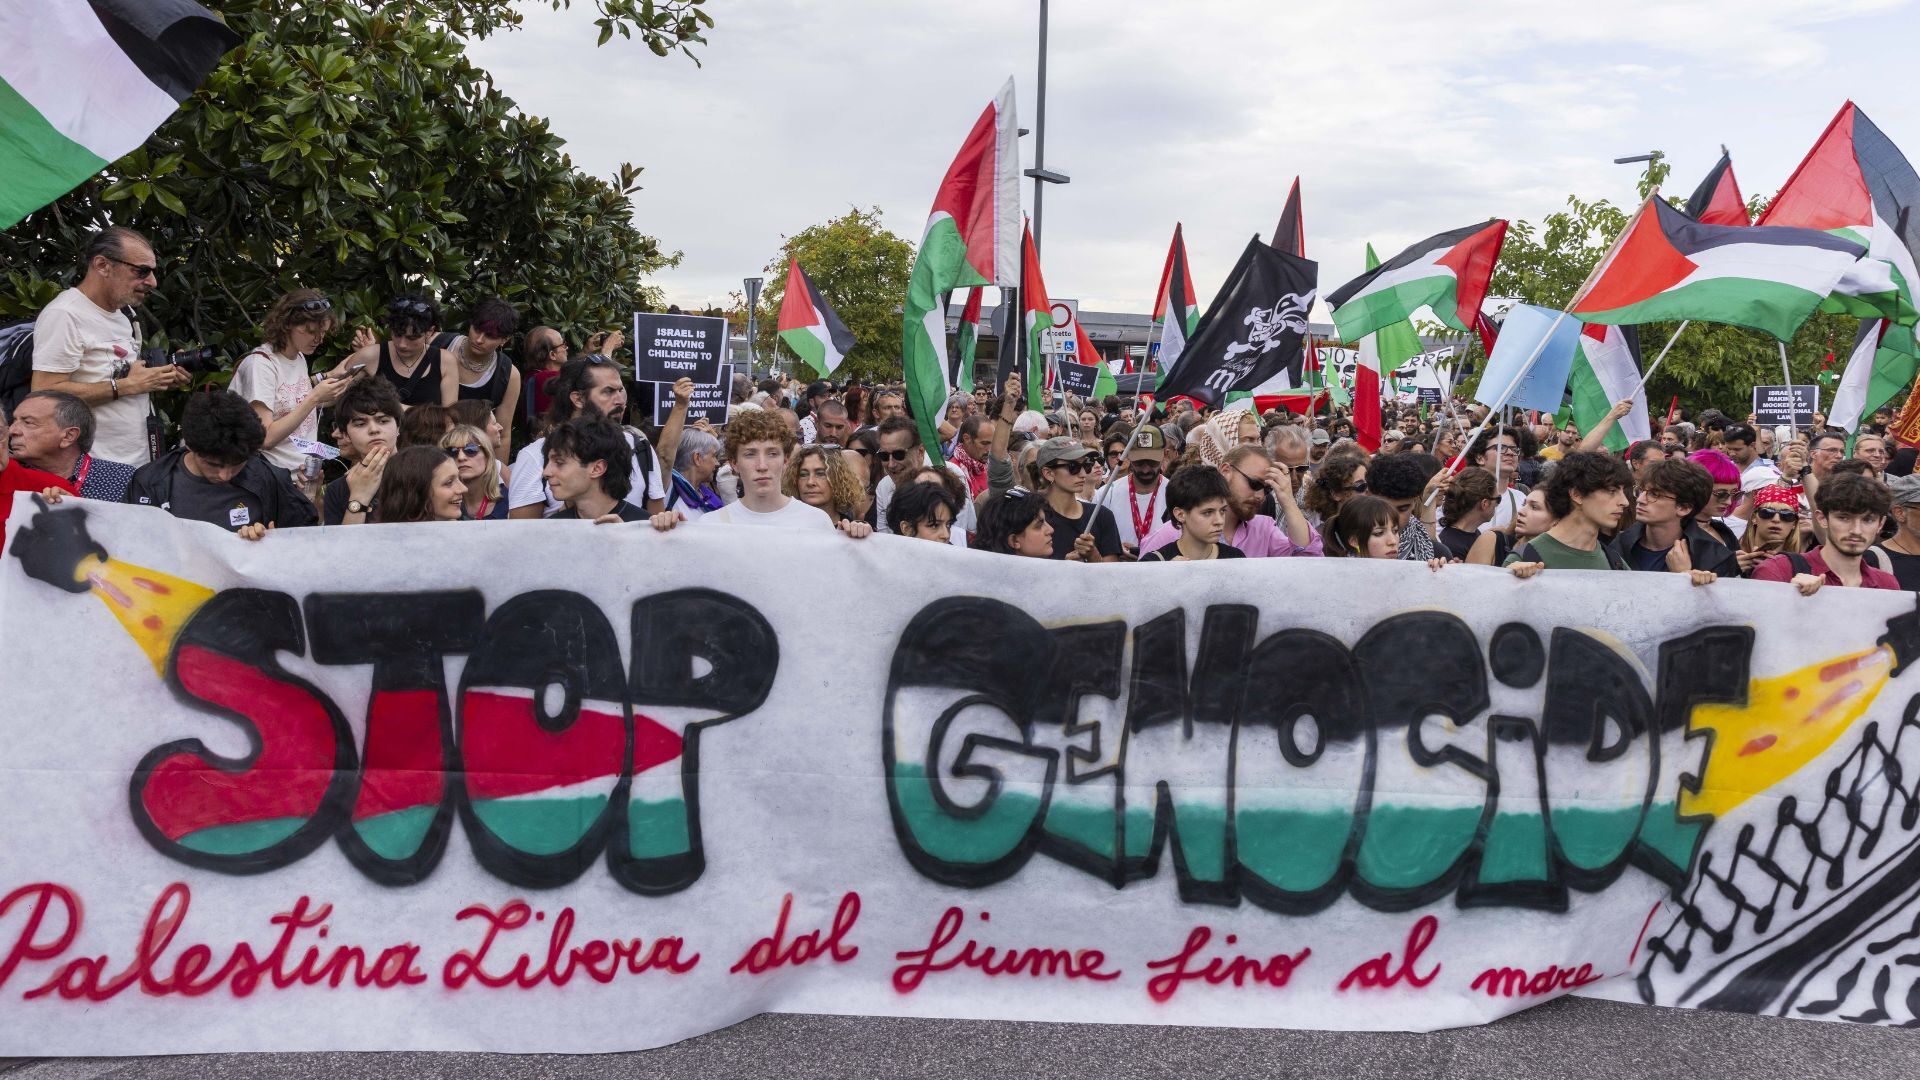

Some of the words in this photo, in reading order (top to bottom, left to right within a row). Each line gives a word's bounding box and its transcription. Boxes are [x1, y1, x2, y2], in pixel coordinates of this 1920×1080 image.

[656, 328, 694, 338] ISRAEL
[696, 330, 706, 338] IS
[654, 339, 705, 349] STARVING
[648, 349, 698, 360] CHILDREN
[700, 352, 712, 360] TO
[664, 361, 697, 370] DEATH
[1062, 380, 1091, 389] ENOCIDE
[130, 588, 779, 897] STOP
[0, 883, 428, 1001] Palestina
[442, 898, 700, 990] Libera
[730, 891, 860, 974] dal
[1338, 915, 1440, 991] al
[1470, 962, 1604, 998] mare
